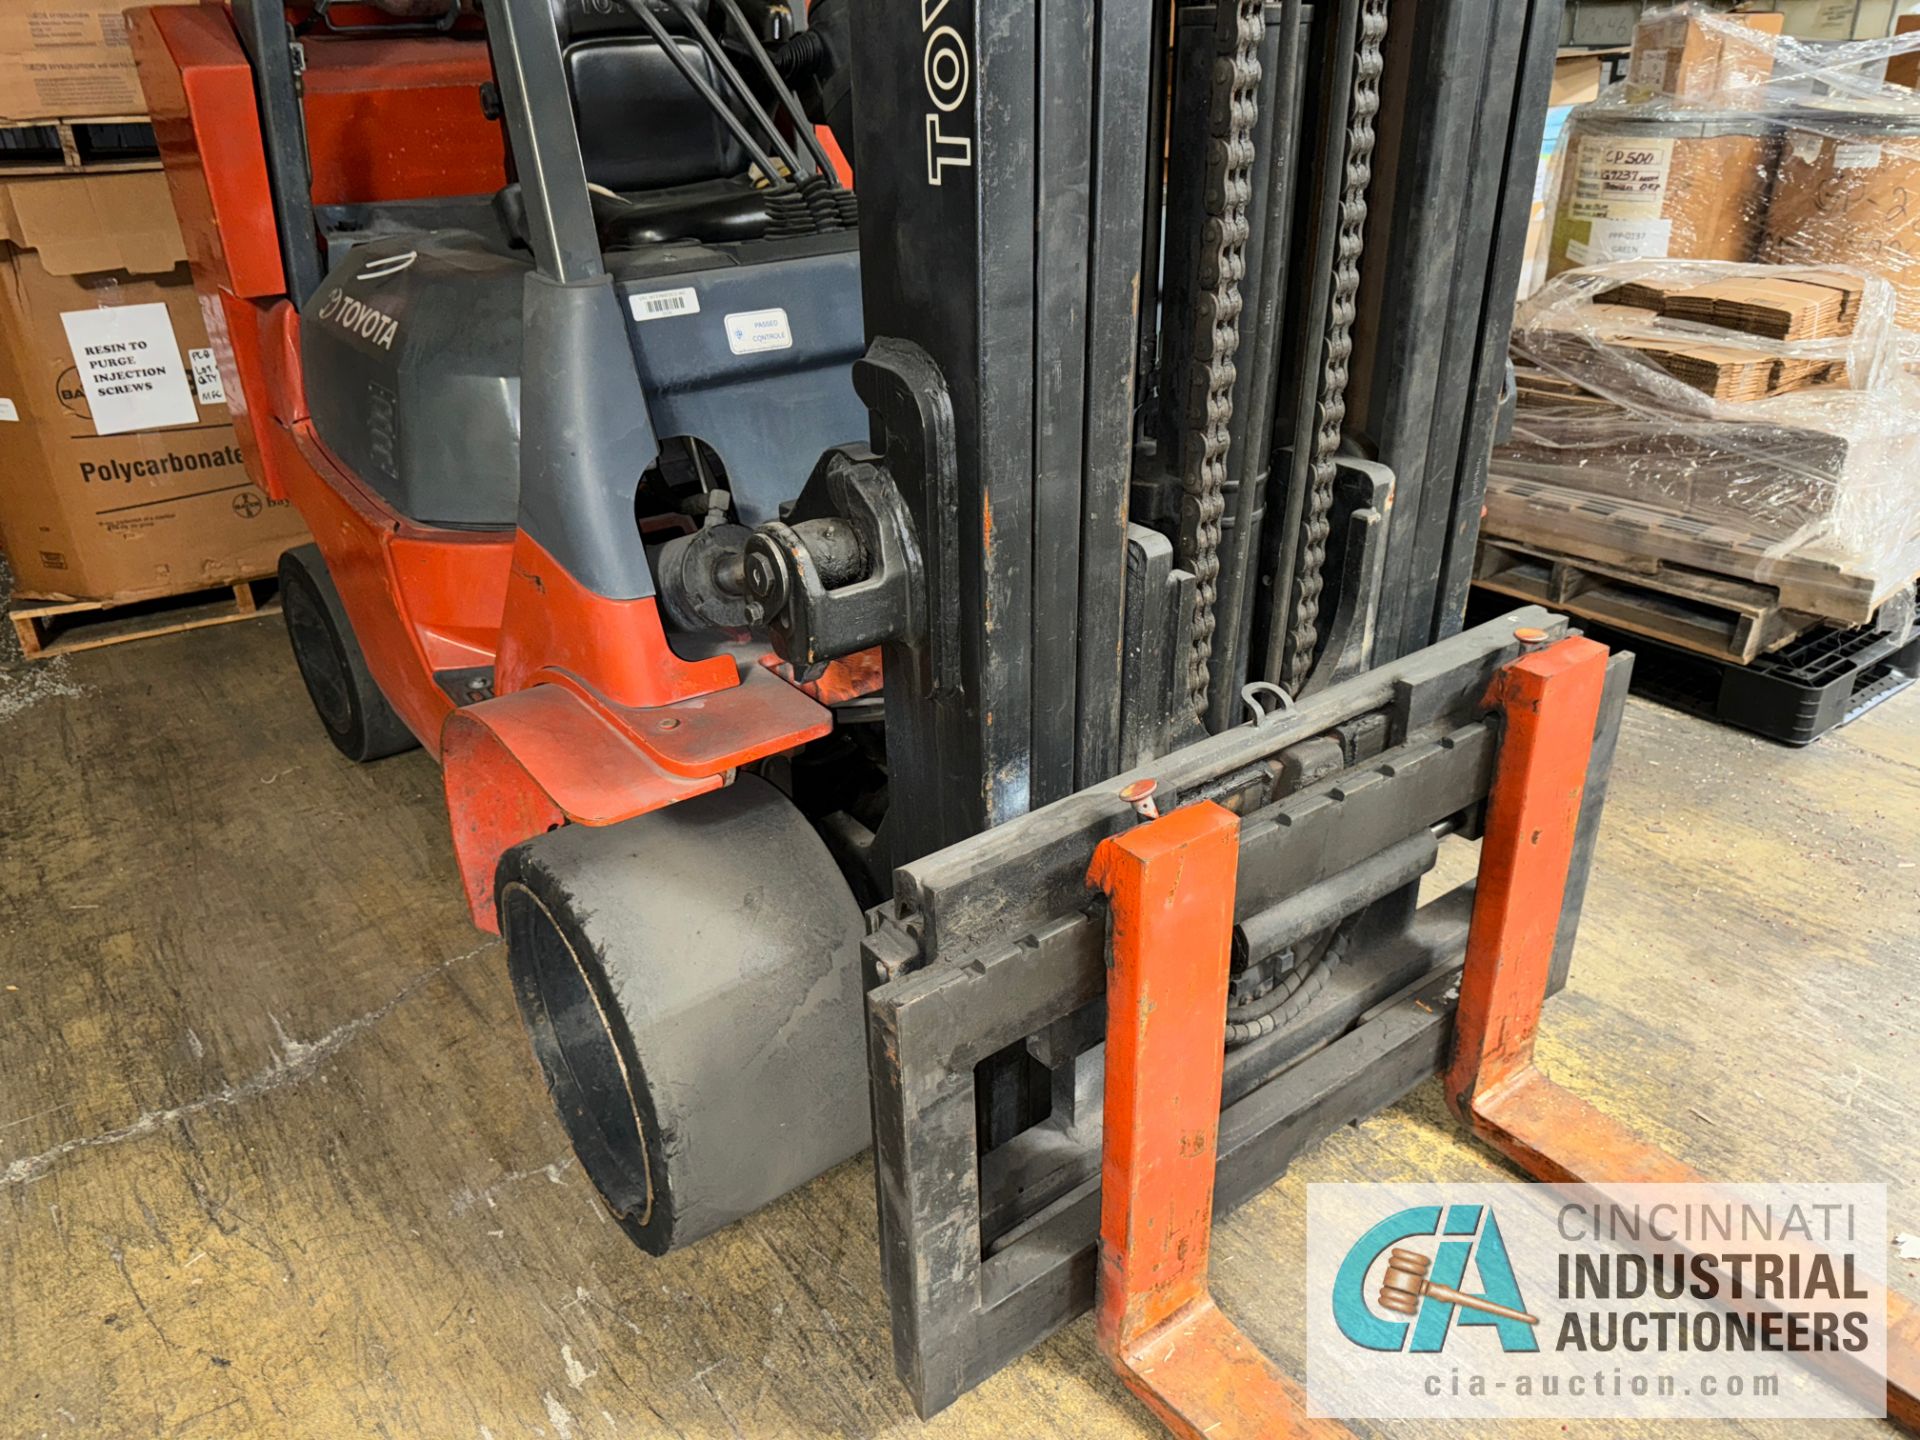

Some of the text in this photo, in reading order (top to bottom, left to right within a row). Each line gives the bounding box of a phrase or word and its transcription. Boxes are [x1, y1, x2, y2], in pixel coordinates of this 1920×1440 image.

[335, 296, 398, 350] TOYOTA
[84, 341, 148, 356] RESIN TO
[89, 356, 137, 370] PURGE
[93, 366, 167, 383] INJECTION
[97, 382, 154, 397] SCREWS
[80, 446, 244, 483] Polycarbonate
